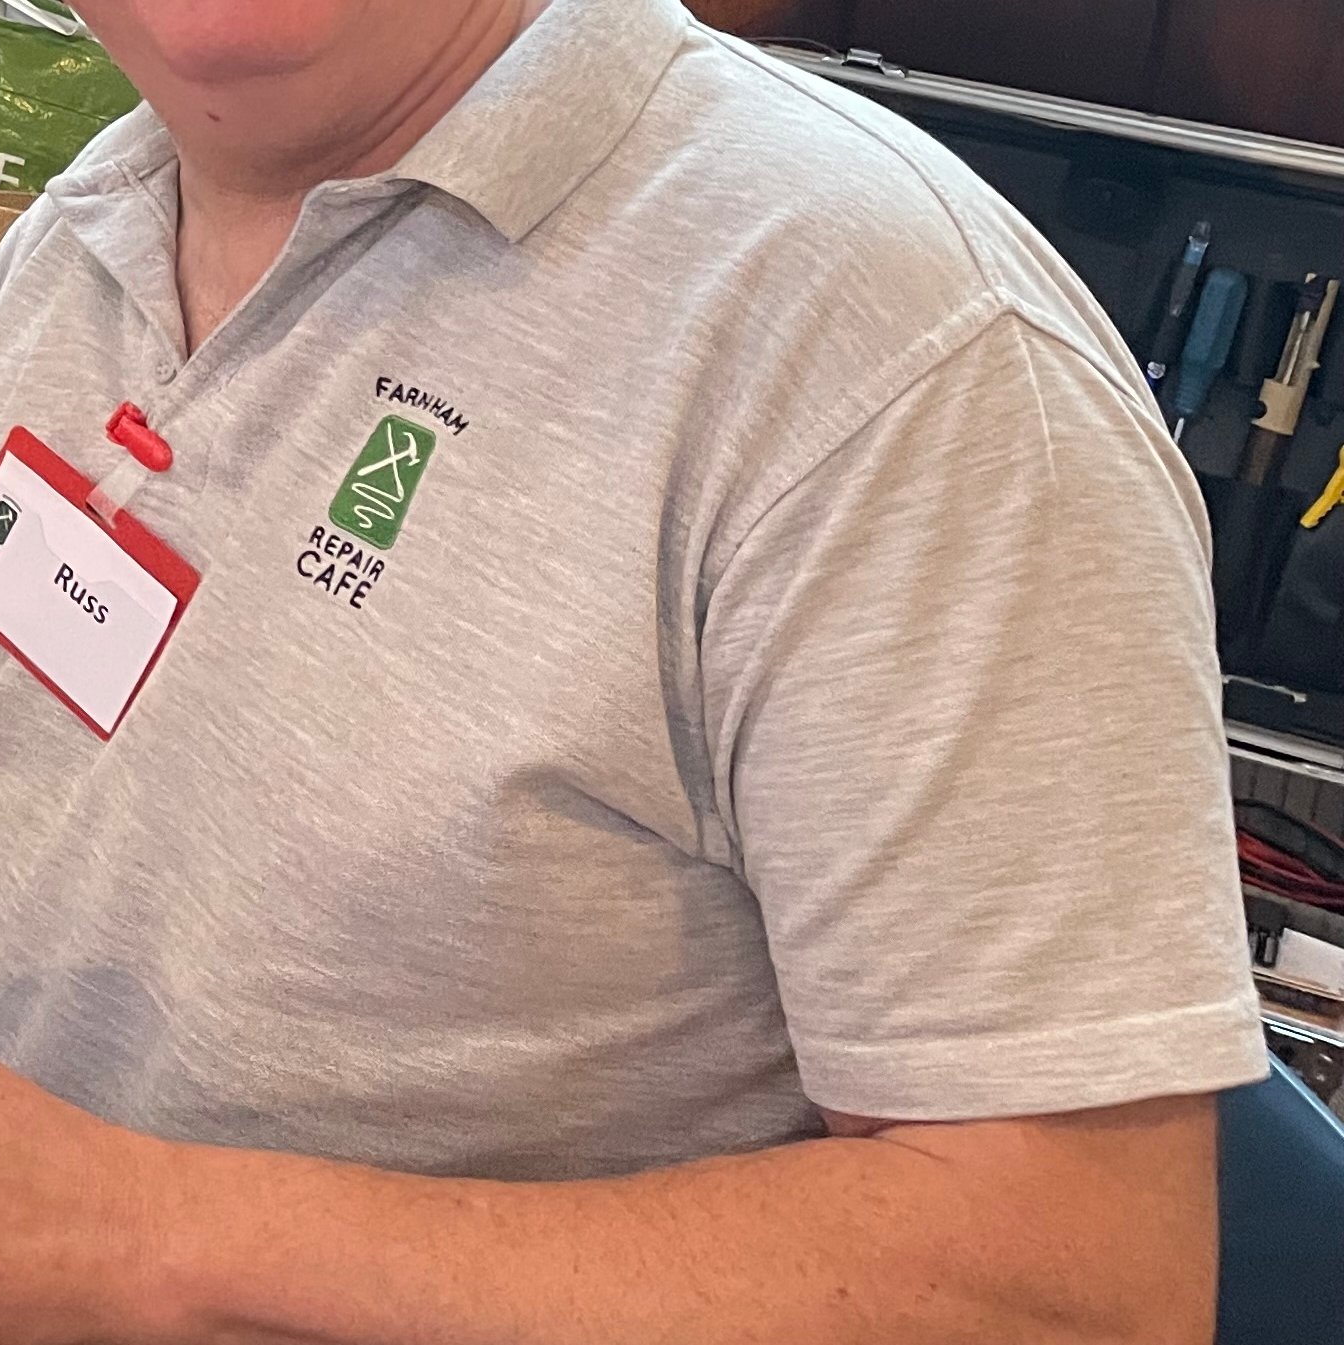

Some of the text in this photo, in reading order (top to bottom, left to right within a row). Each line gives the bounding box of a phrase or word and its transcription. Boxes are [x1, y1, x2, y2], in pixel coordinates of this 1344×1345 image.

[375, 376, 470, 437] FARNHAM
[296, 549, 373, 610] CAFE
[308, 525, 386, 583] REPAIR
[53, 562, 109, 624] Russ
